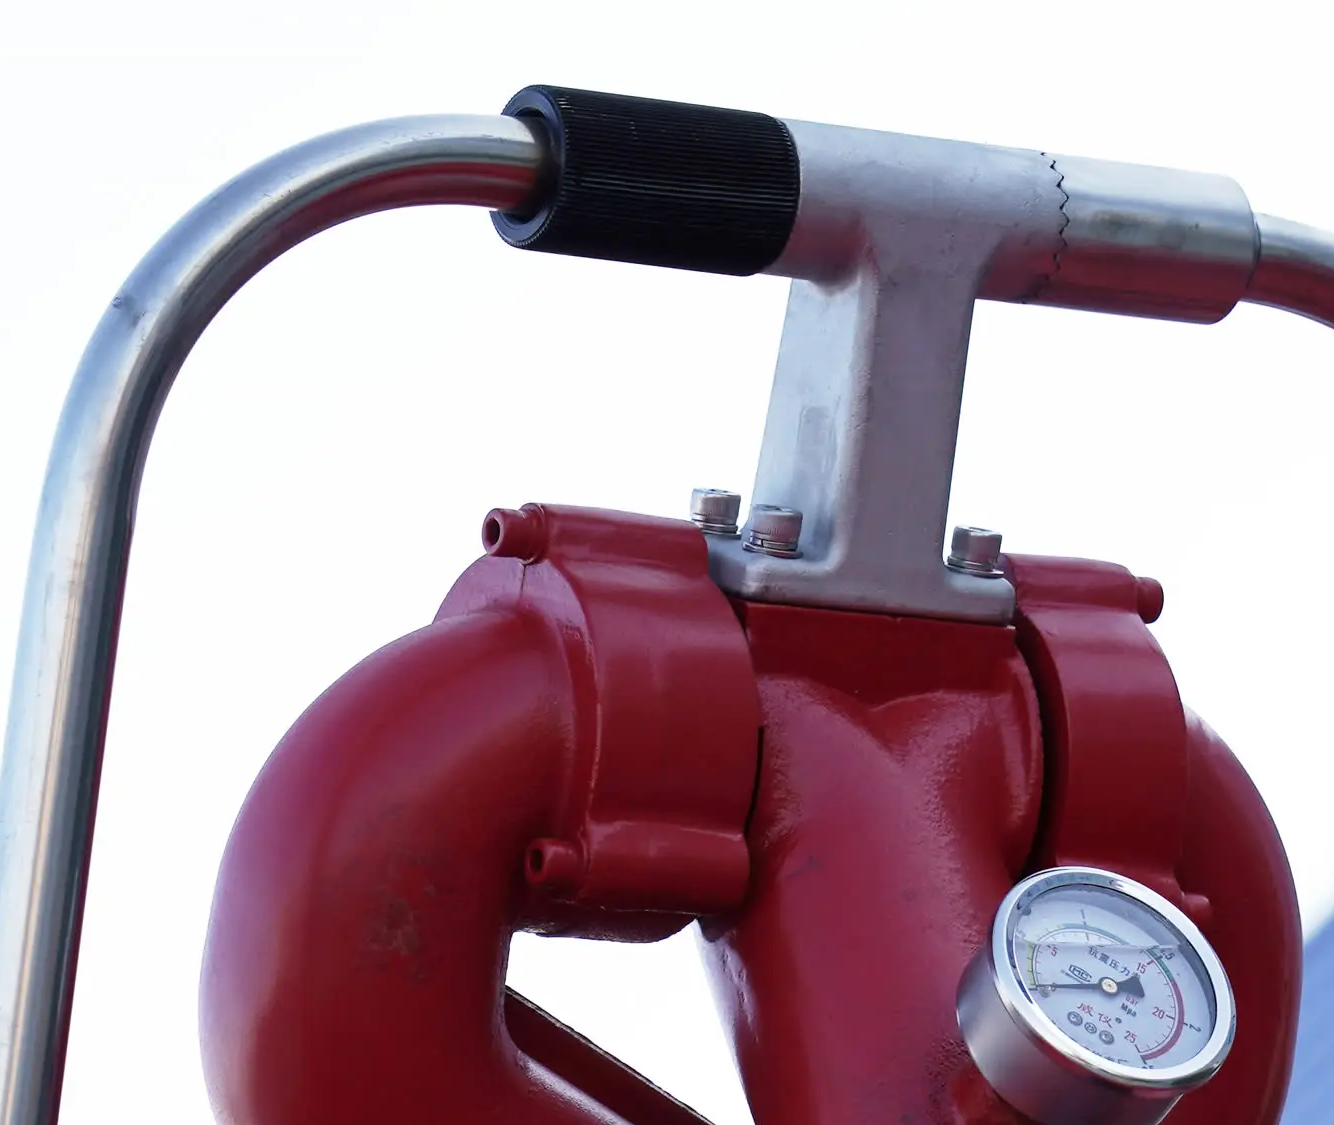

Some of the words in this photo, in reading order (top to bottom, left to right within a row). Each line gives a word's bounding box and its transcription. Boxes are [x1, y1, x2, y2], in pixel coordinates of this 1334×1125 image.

[1088, 945, 1141, 979] 抗震压力
[1136, 962, 1148, 974] 15
[1152, 1006, 1165, 1020] 20
[1124, 1030, 1138, 1044] 25
